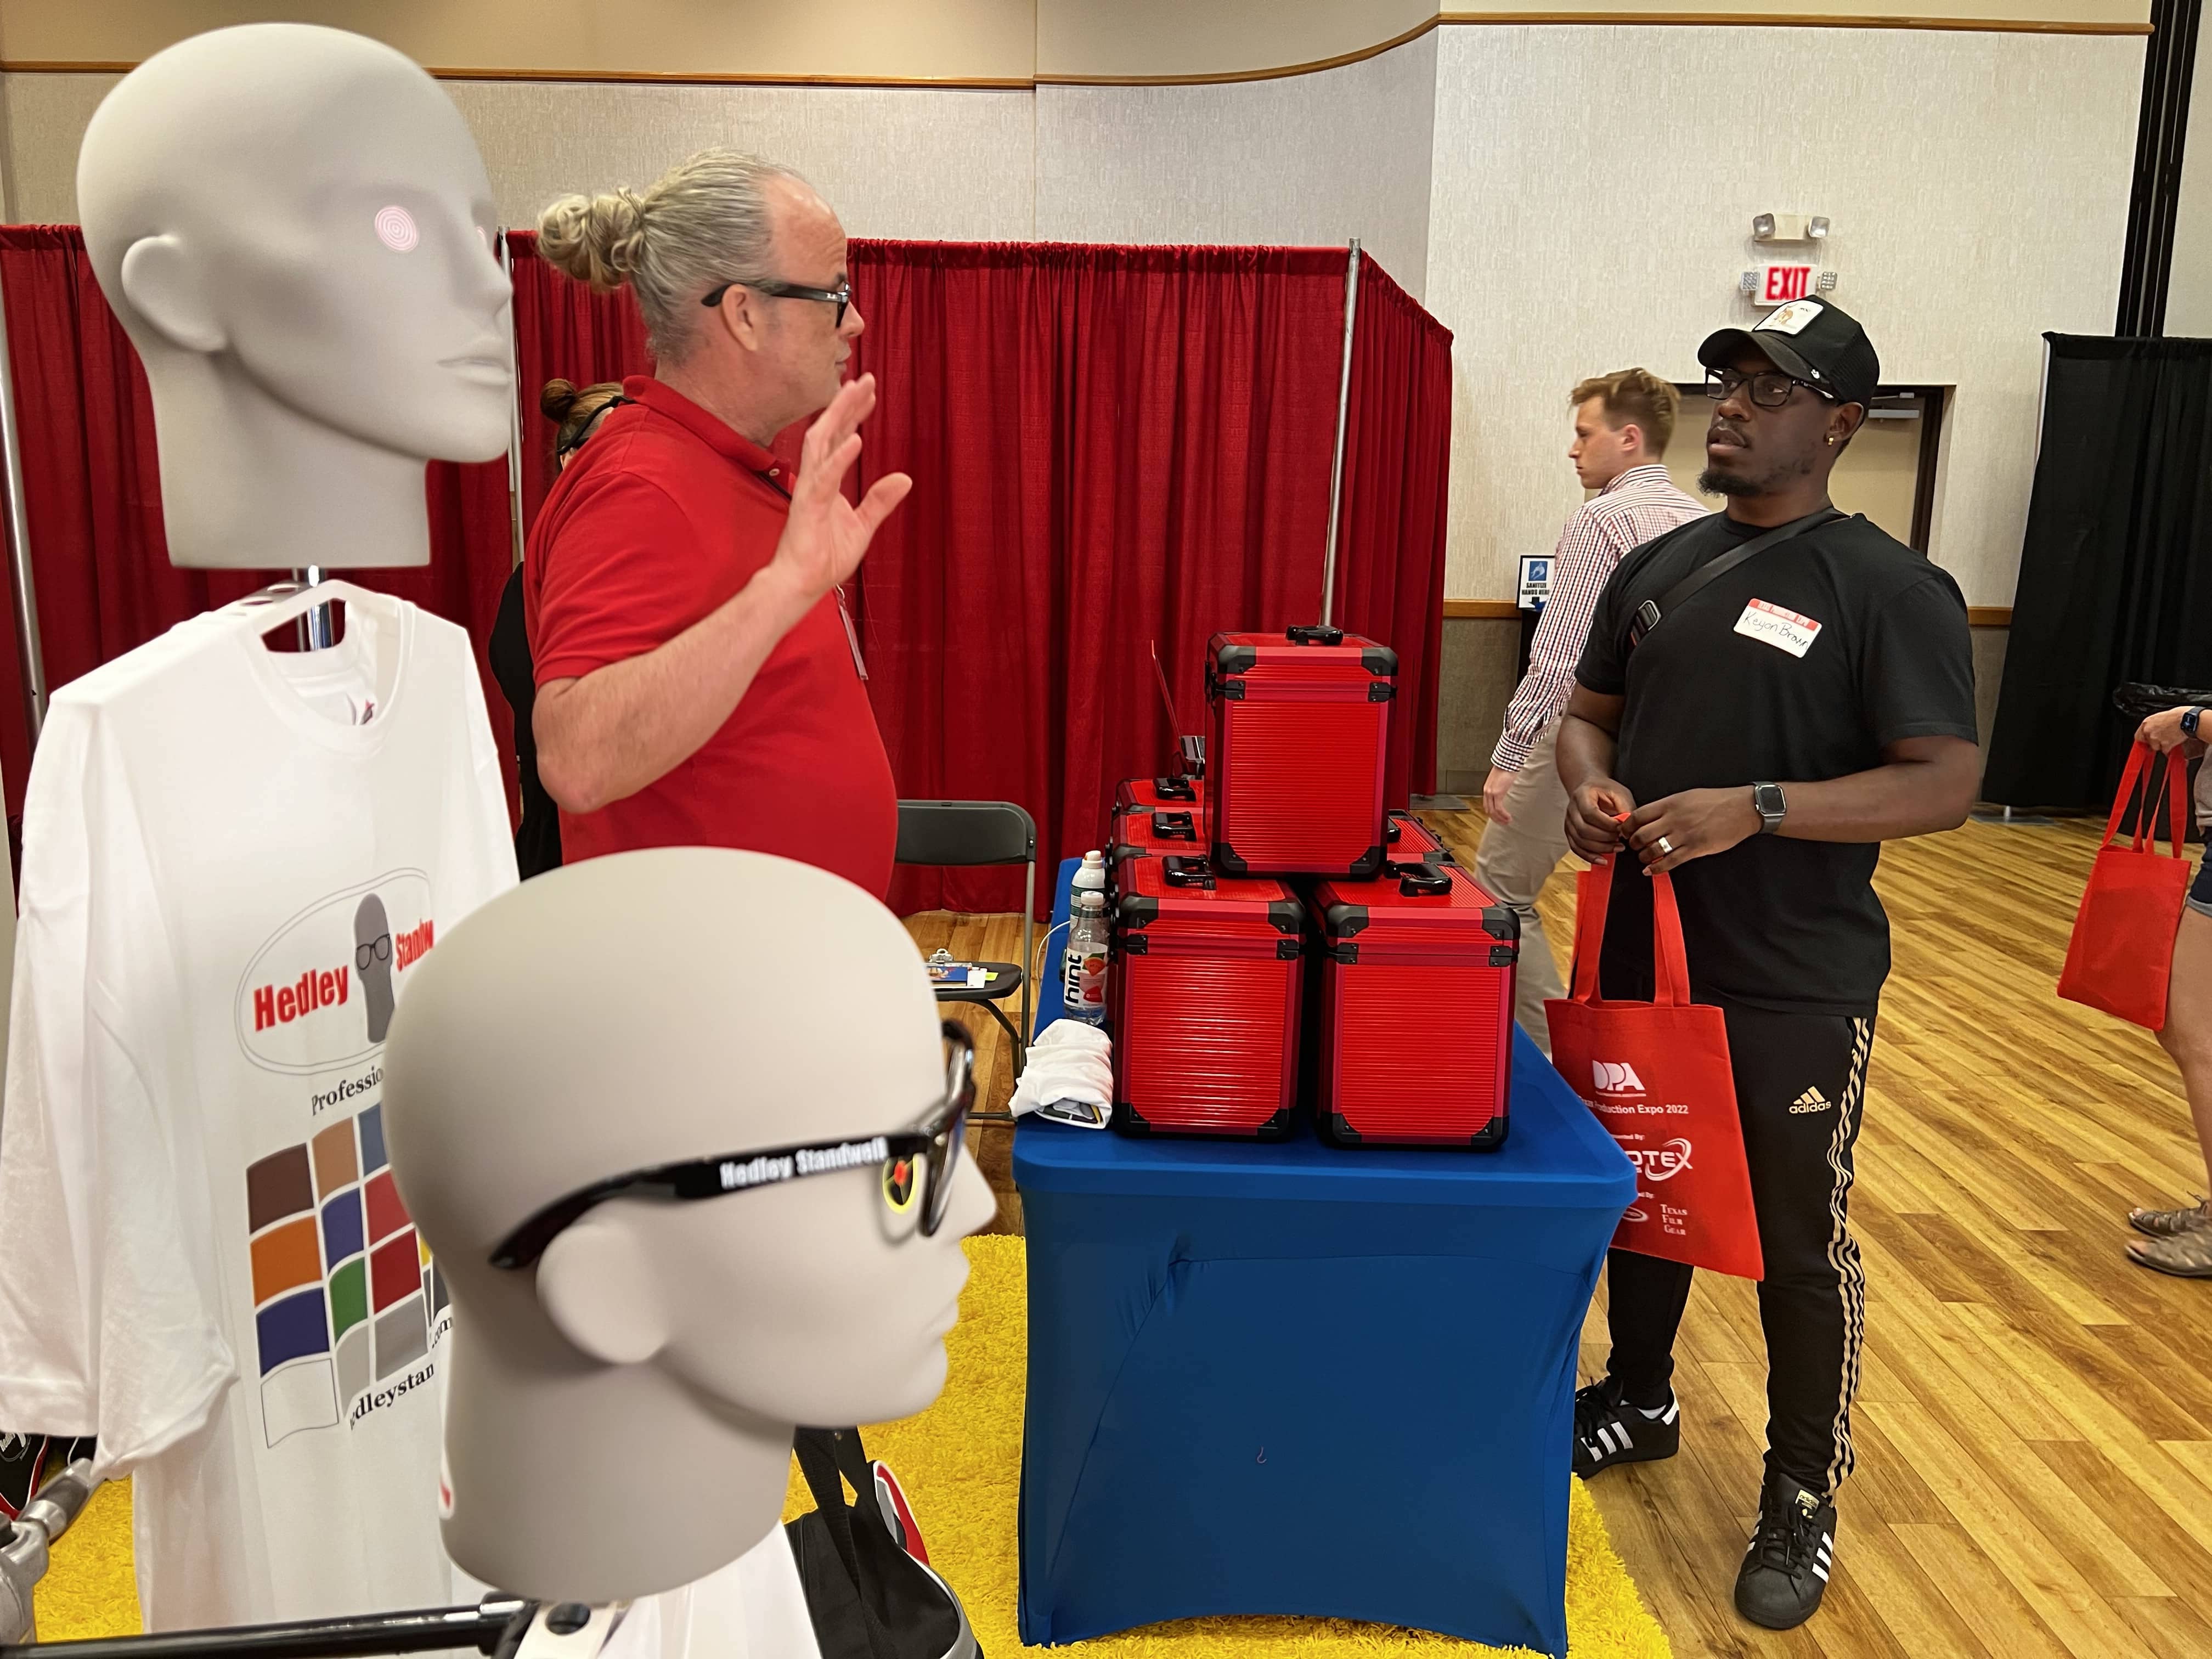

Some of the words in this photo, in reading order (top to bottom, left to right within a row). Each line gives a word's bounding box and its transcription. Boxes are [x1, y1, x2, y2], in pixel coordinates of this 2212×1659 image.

[1765, 267, 1811, 301] EXIT
[1743, 611, 1778, 631] Keyon
[1065, 954, 1082, 1004] hint
[254, 965, 348, 1032] Hedley
[1637, 1104, 1663, 1115] Expo
[1666, 1104, 1689, 1114] 2022
[1788, 1101, 1832, 1114] adidas
[719, 1156, 793, 1189] Hedley
[795, 1136, 888, 1175] Standwell
